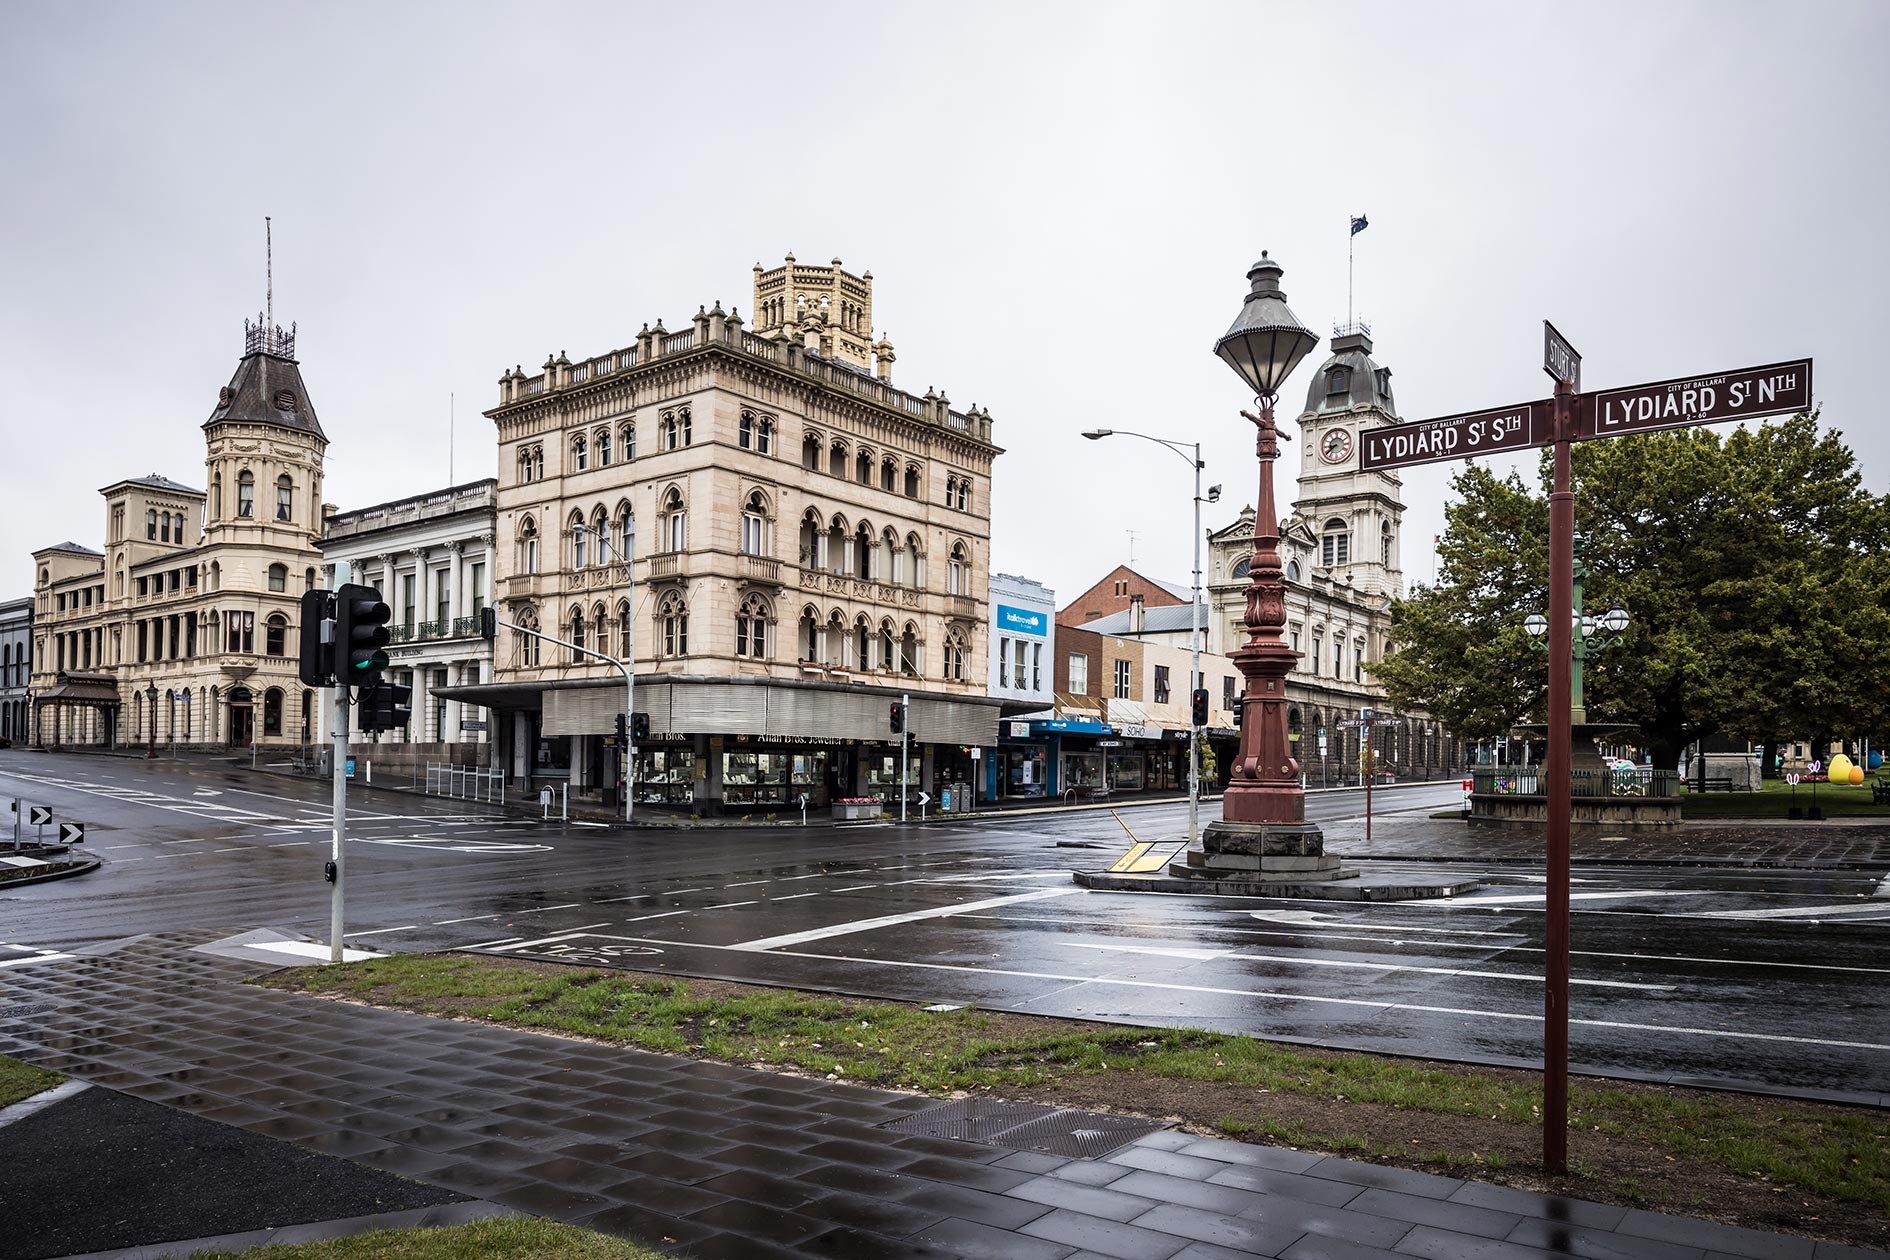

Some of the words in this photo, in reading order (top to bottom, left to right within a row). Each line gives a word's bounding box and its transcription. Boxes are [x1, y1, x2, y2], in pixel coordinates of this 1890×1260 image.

[1550, 339, 1569, 377] STURT
[1668, 384, 1682, 393] CITY
[1693, 377, 1726, 389] BALLARAT
[1605, 388, 1716, 425] LYDIARD
[1728, 381, 1752, 407] ST
[1759, 373, 1796, 403] NTH
[1439, 418, 1466, 428] BALLARAT
[1370, 427, 1458, 461] LYDIARD
[1468, 421, 1487, 446] ST
[1492, 415, 1521, 442] STH
[784, 734, 807, 744] Bros.
[1127, 726, 1146, 737] SOHO
